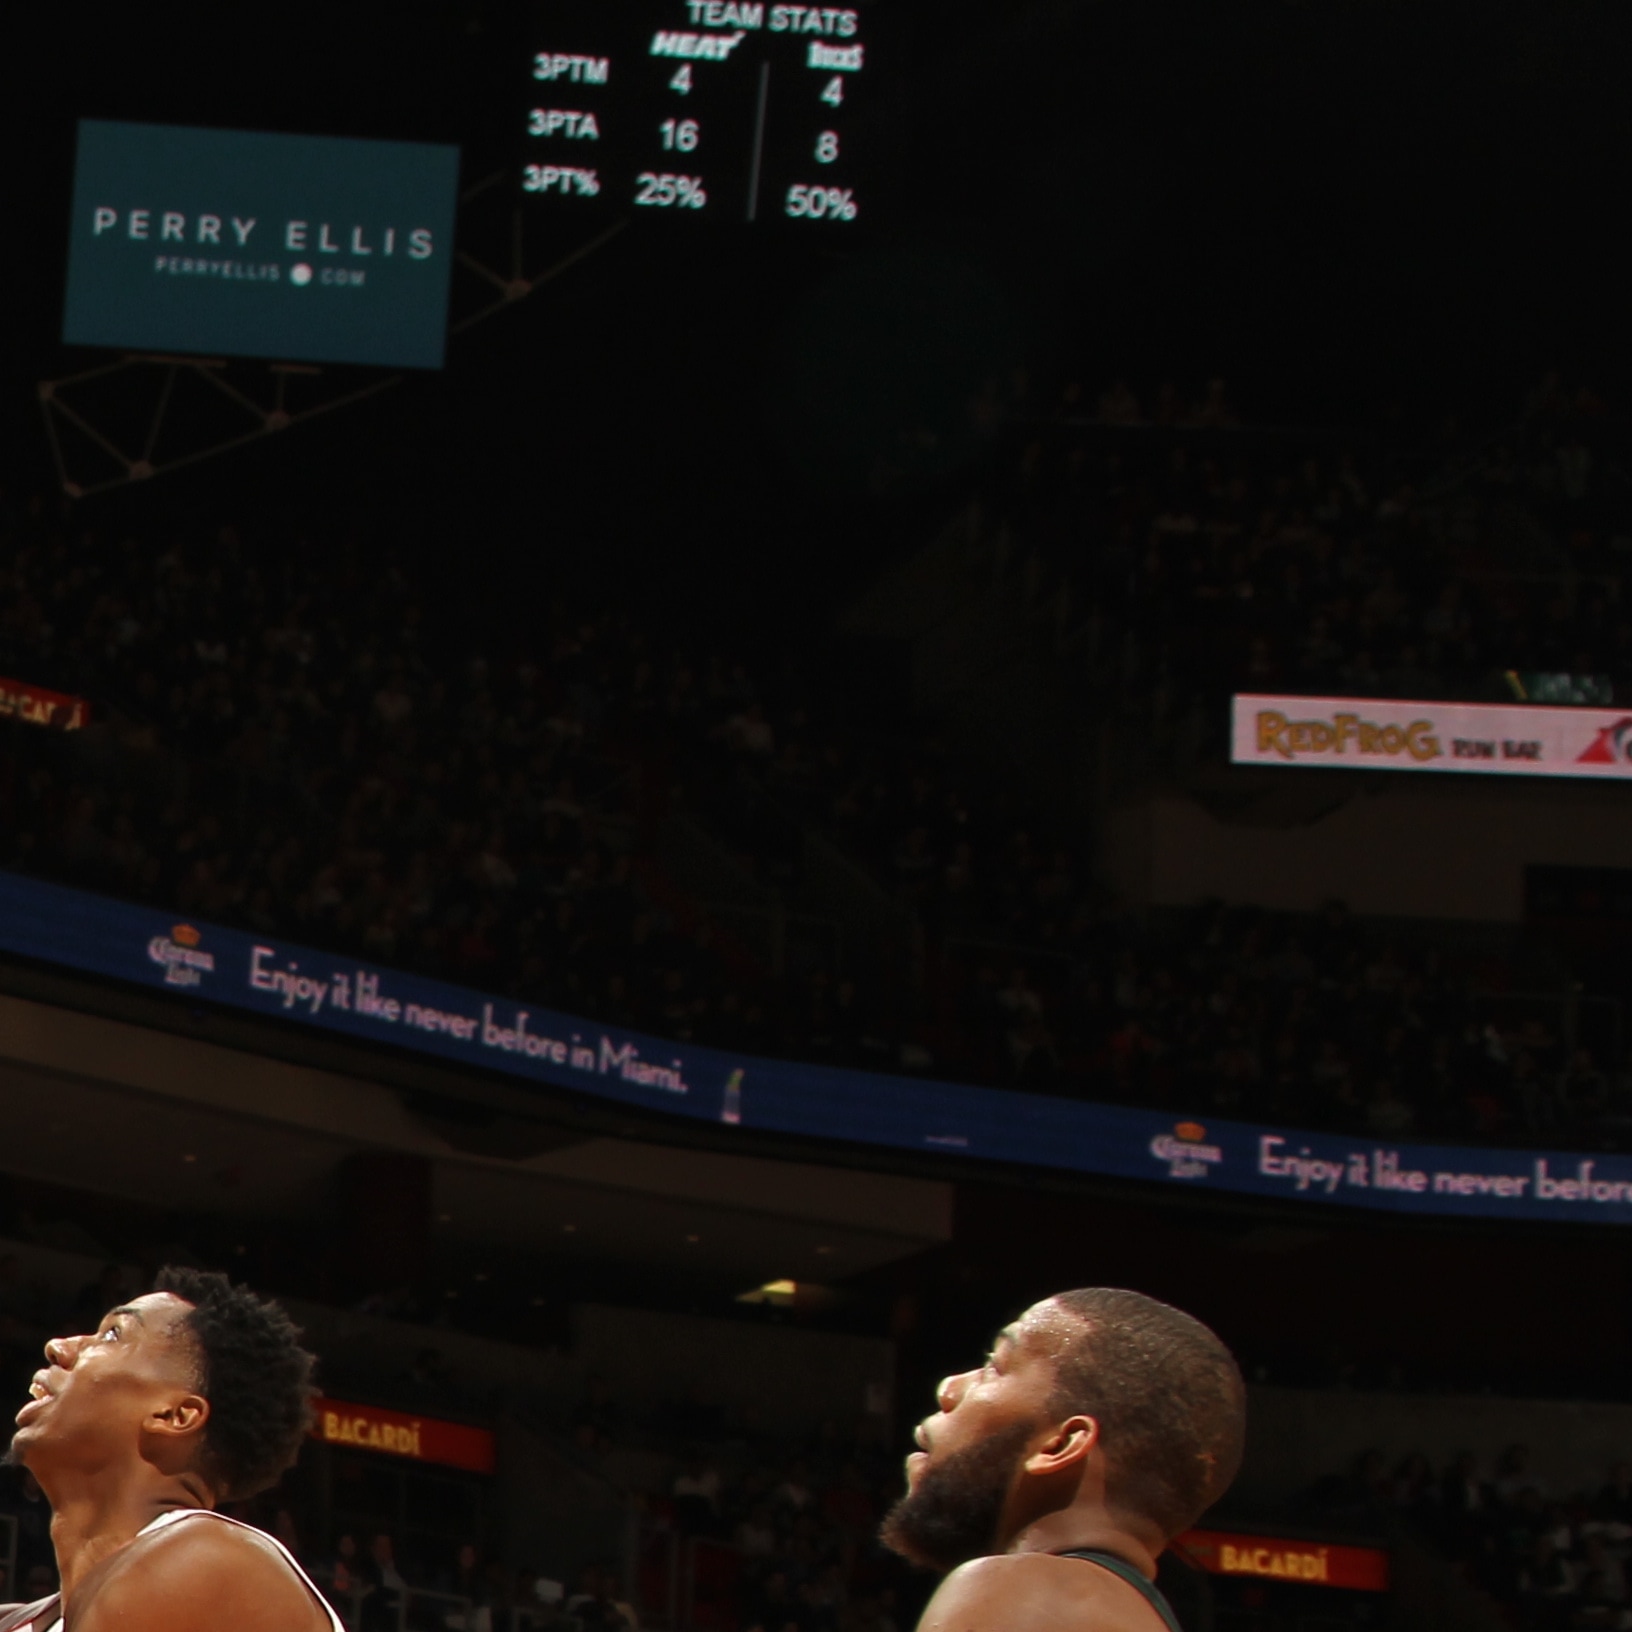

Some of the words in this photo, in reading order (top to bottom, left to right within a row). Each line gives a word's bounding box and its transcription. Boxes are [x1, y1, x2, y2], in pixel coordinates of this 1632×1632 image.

[649, 29, 747, 61] HEAT
[686, 0, 764, 29] TEAM
[767, 3, 858, 38] STATS
[532, 52, 610, 85] 3PTM
[668, 63, 693, 96] 4
[819, 75, 844, 108] 4
[527, 108, 599, 141] 3PTA
[658, 117, 700, 153] 16
[814, 130, 839, 164] 8
[522, 164, 601, 197] 3PT%
[635, 171, 707, 209] 25%
[784, 184, 859, 221] 50%
[92, 207, 256, 246] PERRY
[285, 220, 434, 260] ELLIS
[154, 254, 282, 282] PERRYELLIS
[249, 946, 329, 1014] Enjoy
[331, 971, 352, 1009] it
[355, 971, 400, 1023] like
[404, 1004, 475, 1042] never
[481, 1003, 566, 1065] before
[571, 1028, 595, 1071] in
[599, 1034, 688, 1095] Miami.
[1258, 1135, 1344, 1193] Enjoy
[1346, 1151, 1369, 1187] it
[1373, 1149, 1428, 1193] like
[1433, 1170, 1530, 1198] never
